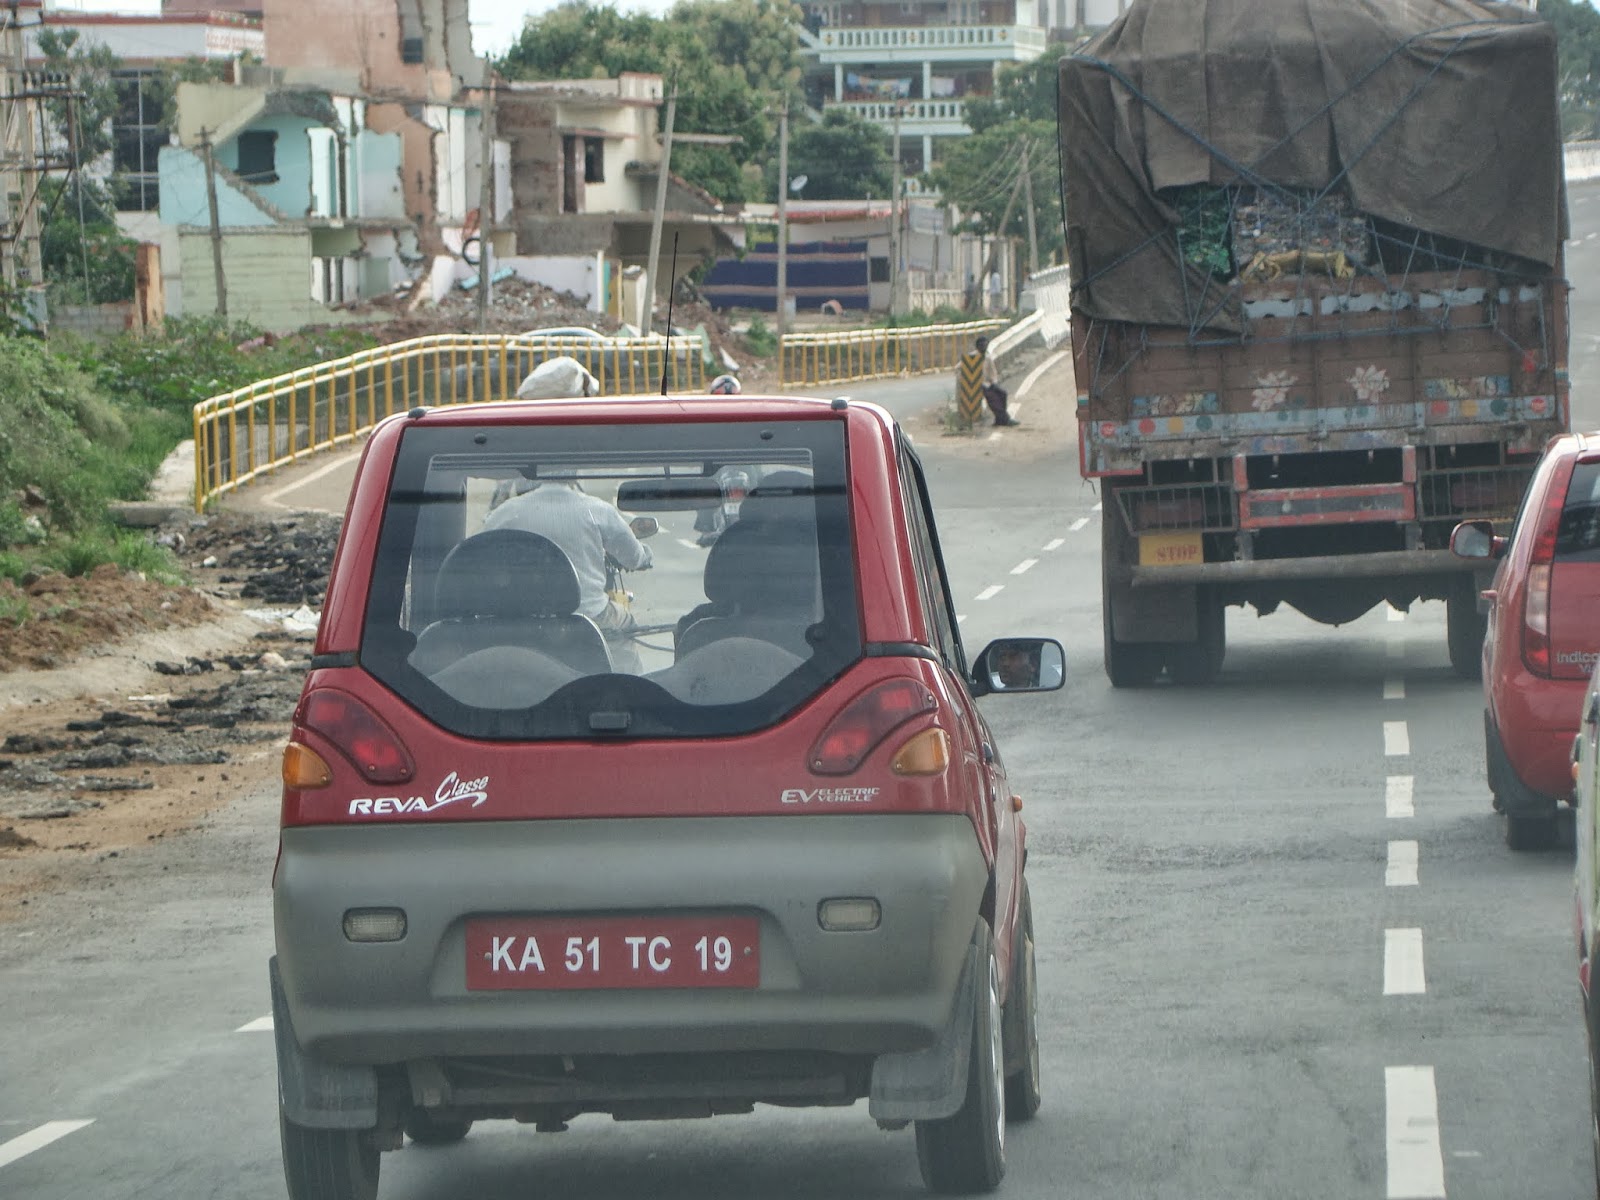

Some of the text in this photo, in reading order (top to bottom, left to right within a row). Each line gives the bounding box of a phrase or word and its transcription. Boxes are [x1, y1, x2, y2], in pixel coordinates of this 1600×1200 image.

[1156, 545, 1199, 561] STOP
[349, 771, 489, 814] REVA Classe
[781, 789, 818, 803] EV
[818, 787, 880, 795] ELECTRIC
[491, 935, 732, 972] KA 51 TC 19
